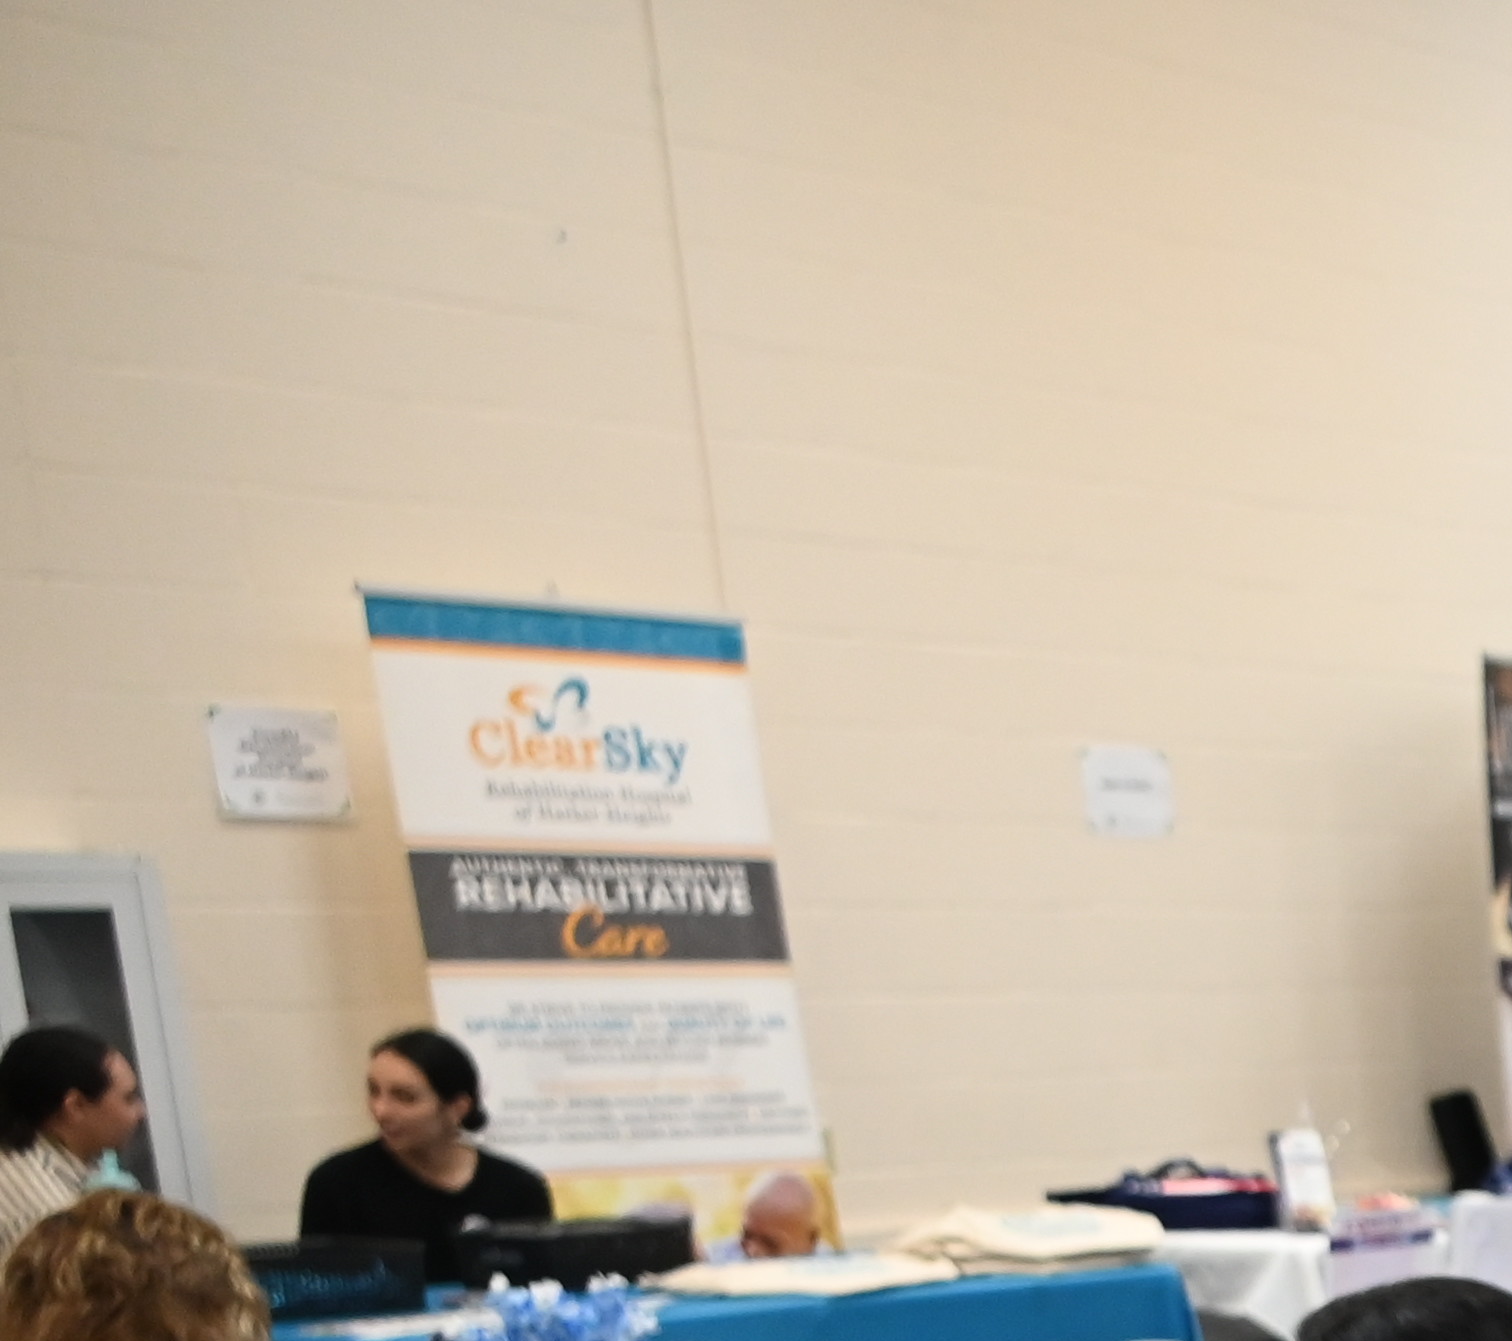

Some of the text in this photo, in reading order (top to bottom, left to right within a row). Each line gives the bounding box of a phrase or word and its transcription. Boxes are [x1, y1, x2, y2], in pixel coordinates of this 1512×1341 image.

[470, 718, 688, 784] ClearSky
[454, 873, 754, 916] REHABILITATIVE
[560, 902, 671, 958] Care
